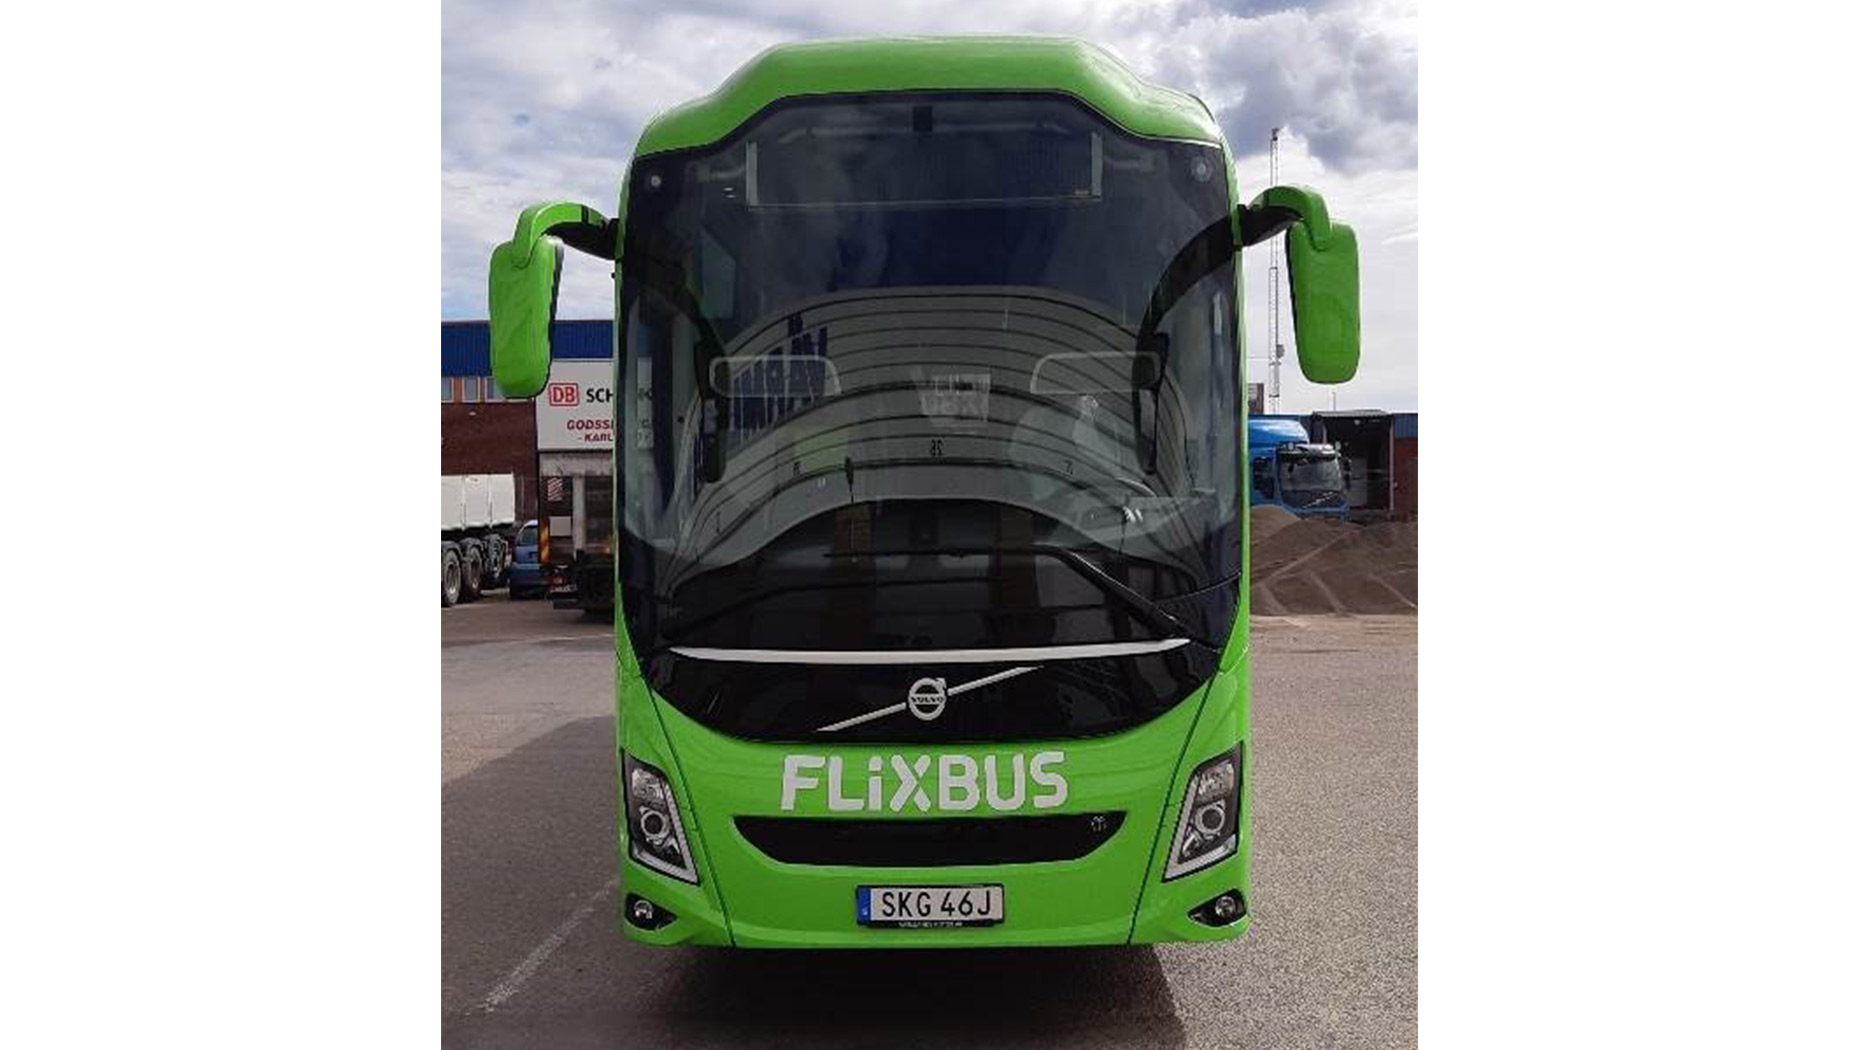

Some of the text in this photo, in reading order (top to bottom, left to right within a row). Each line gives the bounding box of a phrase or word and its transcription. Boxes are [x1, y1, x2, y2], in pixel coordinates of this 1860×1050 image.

[552, 385, 576, 403] DB
[882, 890, 990, 917] SKG 46J
